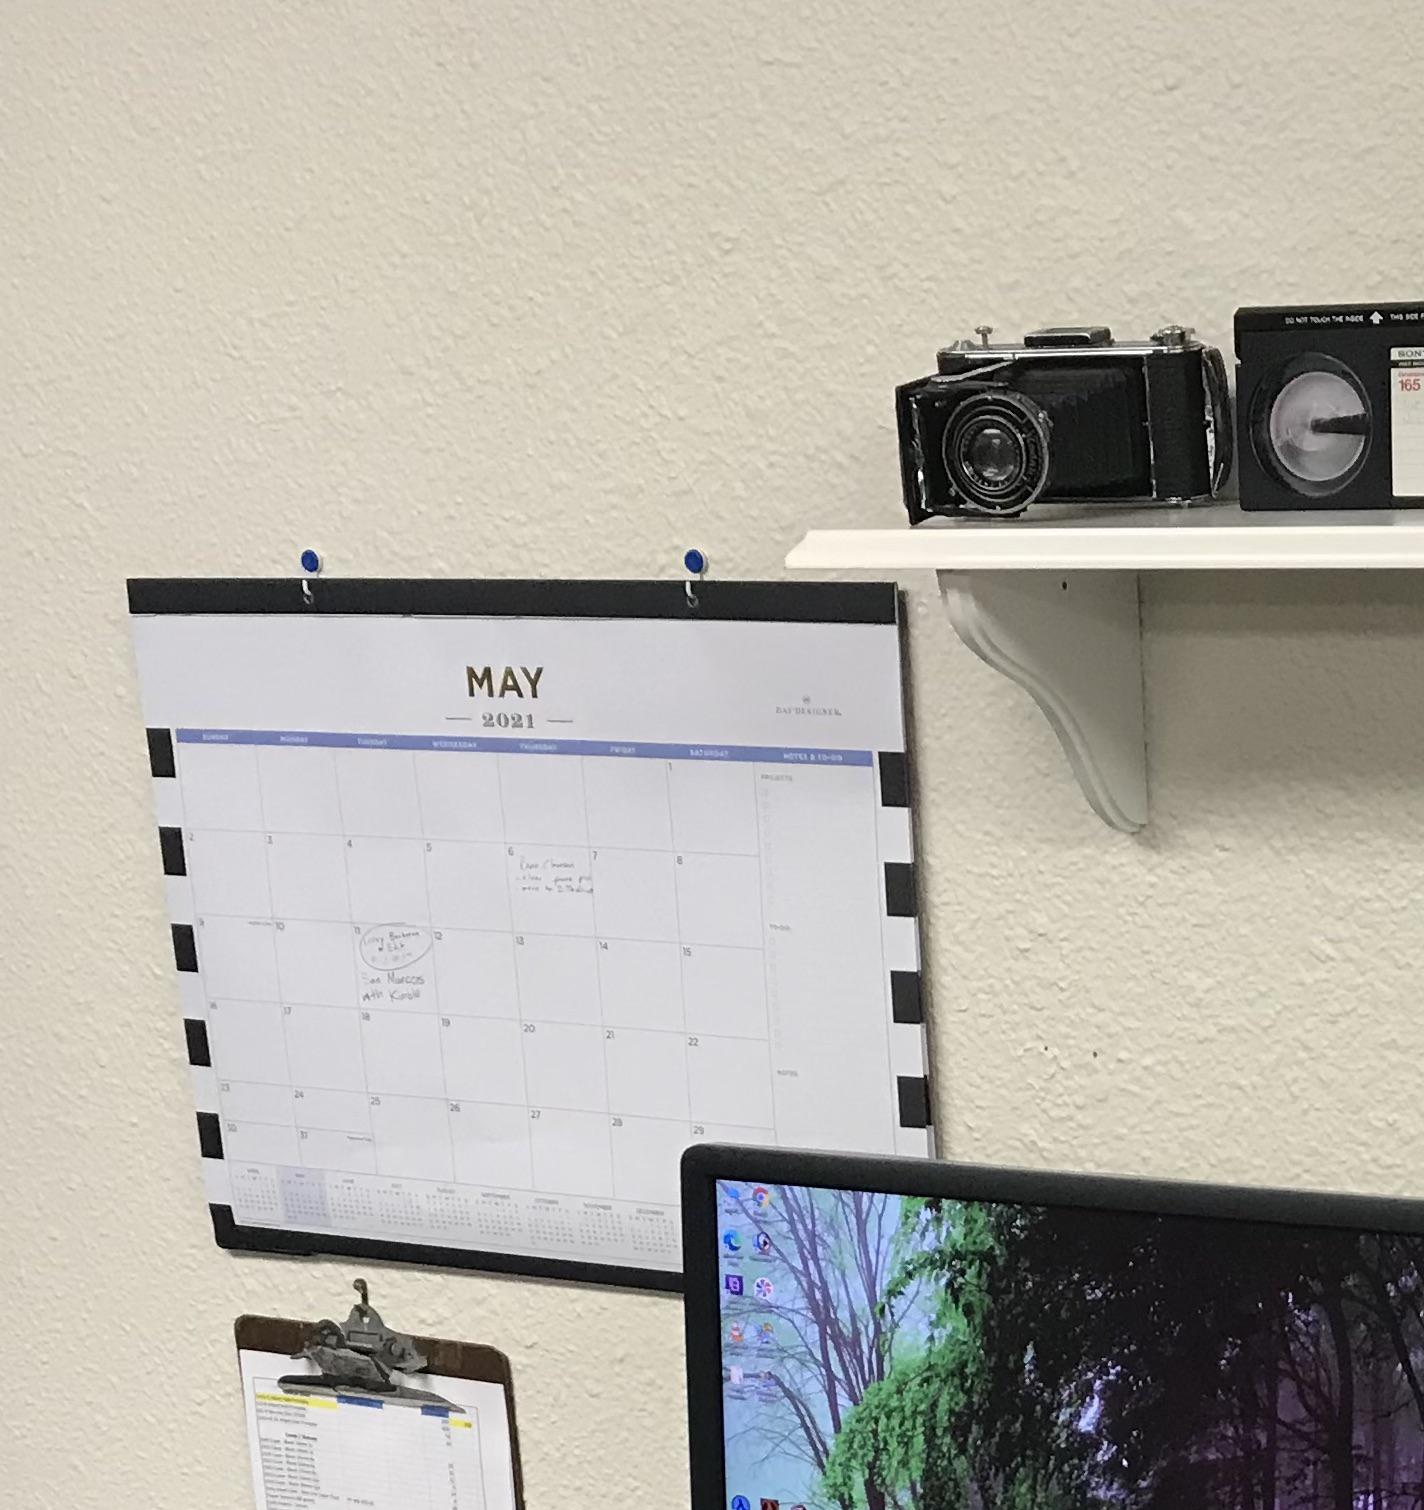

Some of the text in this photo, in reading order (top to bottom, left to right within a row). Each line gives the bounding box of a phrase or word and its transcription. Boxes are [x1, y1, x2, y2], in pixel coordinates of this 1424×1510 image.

[1332, 315, 1344, 323] THE
[1398, 379, 1421, 392] 165
[466, 666, 544, 699] MAY
[482, 712, 535, 729] 2021
[275, 921, 285, 931] 10
[434, 931, 443, 941] 12
[516, 936, 525, 945] 13
[599, 941, 609, 951] 14
[682, 947, 692, 957] 15
[284, 1006, 292, 1015] 17
[361, 1012, 370, 1021] 18
[442, 1018, 450, 1027] 19
[523, 1024, 536, 1033] 20
[606, 1030, 615, 1040] 21
[688, 1037, 699, 1047] 22
[294, 1090, 304, 1099] 24
[370, 1096, 381, 1105] 25
[450, 1103, 461, 1113] 26
[531, 1110, 541, 1120] 27
[693, 1125, 705, 1135] 29
